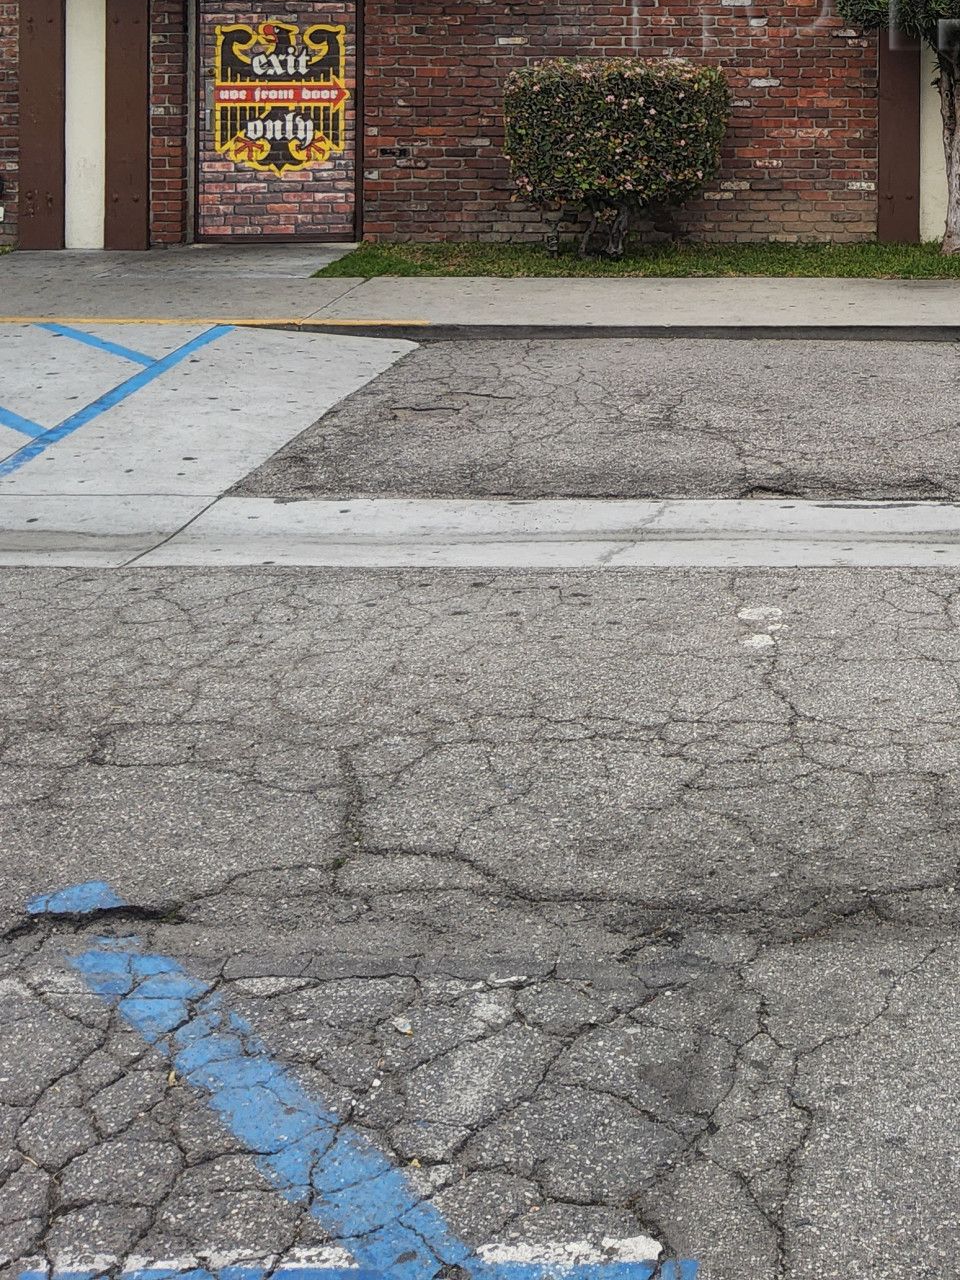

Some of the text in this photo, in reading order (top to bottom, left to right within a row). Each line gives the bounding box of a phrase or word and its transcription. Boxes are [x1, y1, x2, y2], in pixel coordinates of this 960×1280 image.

[252, 47, 311, 75] exit
[219, 85, 339, 103] use front door
[246, 112, 314, 148] only
